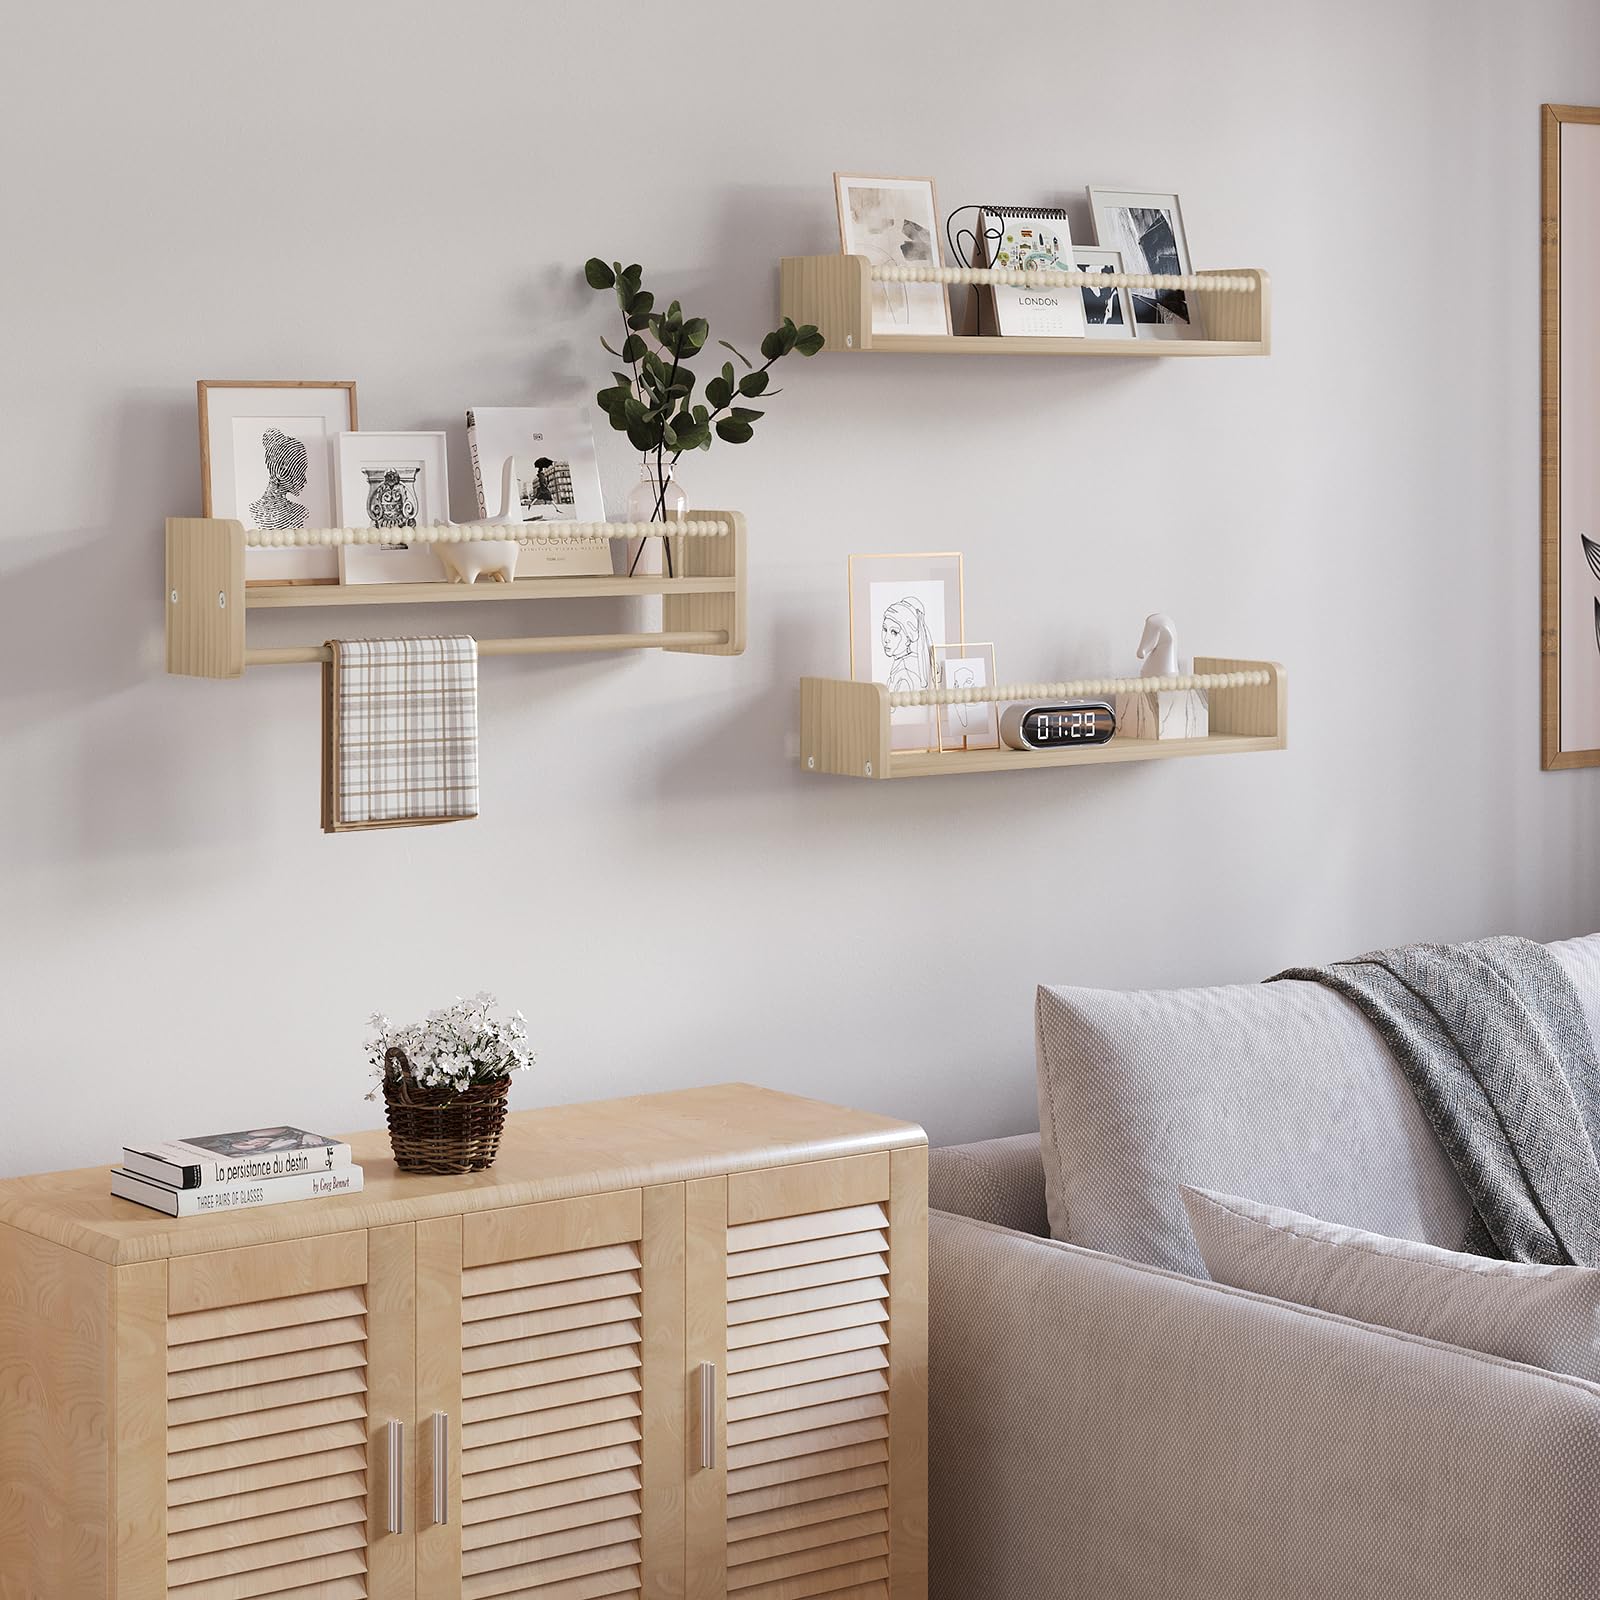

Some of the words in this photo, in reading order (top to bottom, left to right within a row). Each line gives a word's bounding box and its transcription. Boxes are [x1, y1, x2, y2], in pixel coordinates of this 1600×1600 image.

[1018, 297, 1058, 306] LONDON
[471, 443, 487, 519] PHOTOG
[518, 535, 606, 546] OTOGRAPHY
[1037, 712, 1096, 740] 01:29
[214, 1162, 225, 1182] La
[226, 1159, 271, 1184] persistance
[273, 1154, 284, 1174] du
[285, 1152, 309, 1172] destin
[197, 1195, 214, 1209] THREE
[215, 1192, 231, 1207] PAIRS
[232, 1191, 239, 1205] OF
[240, 1188, 264, 1203] GLASSES
